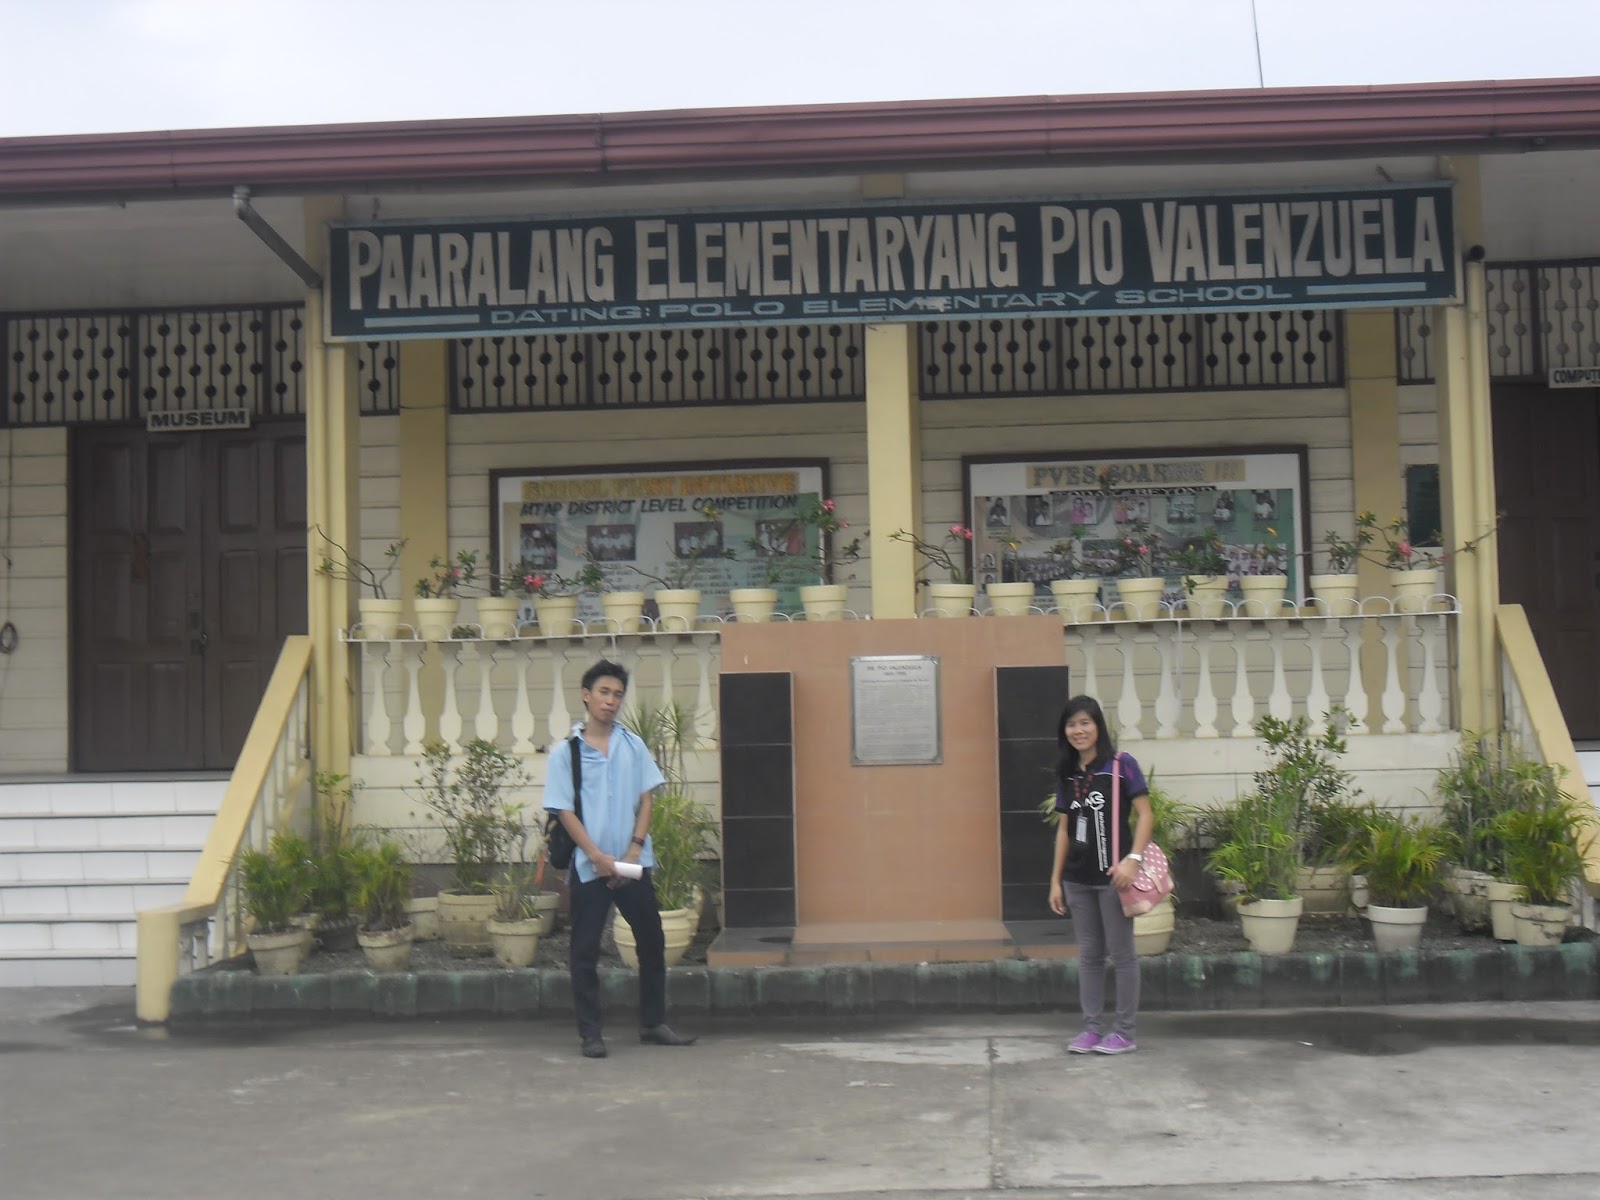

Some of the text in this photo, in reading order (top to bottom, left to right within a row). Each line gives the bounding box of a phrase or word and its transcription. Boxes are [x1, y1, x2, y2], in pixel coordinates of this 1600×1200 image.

[348, 197, 1445, 310] PAARALANG ELEMENTARYANG PIO VALENZUELA
[490, 284, 1292, 325] DATING: POLO ELEMENTARY SCHOOL
[151, 410, 246, 427] MUSEUM
[568, 500, 636, 515] DISTRICT
[640, 498, 688, 513] LEVEL
[693, 495, 799, 512] COMPETITION
